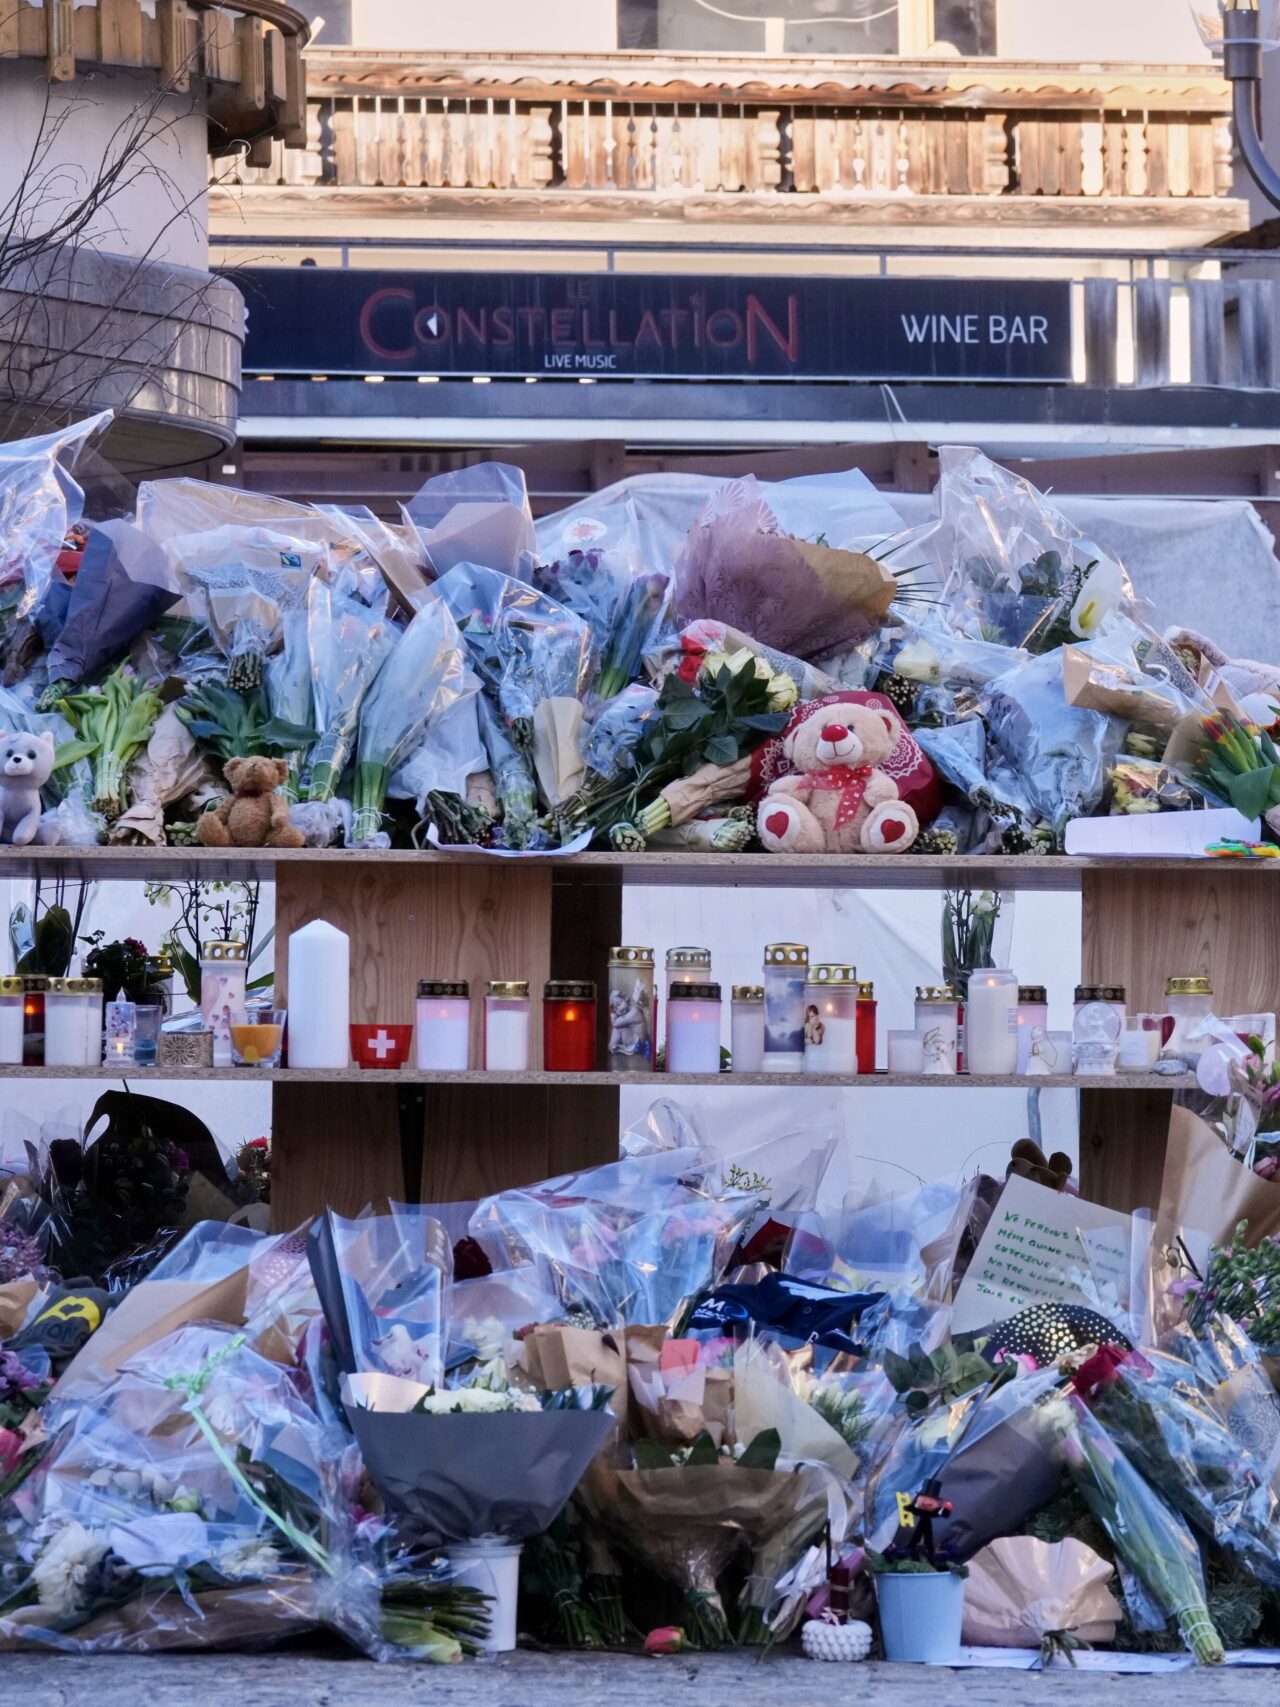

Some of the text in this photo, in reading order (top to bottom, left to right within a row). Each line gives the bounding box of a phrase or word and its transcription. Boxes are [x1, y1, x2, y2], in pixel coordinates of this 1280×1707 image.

[901, 314, 1049, 344] WINE BAR
[544, 354, 617, 369] LIVE MUSIC
